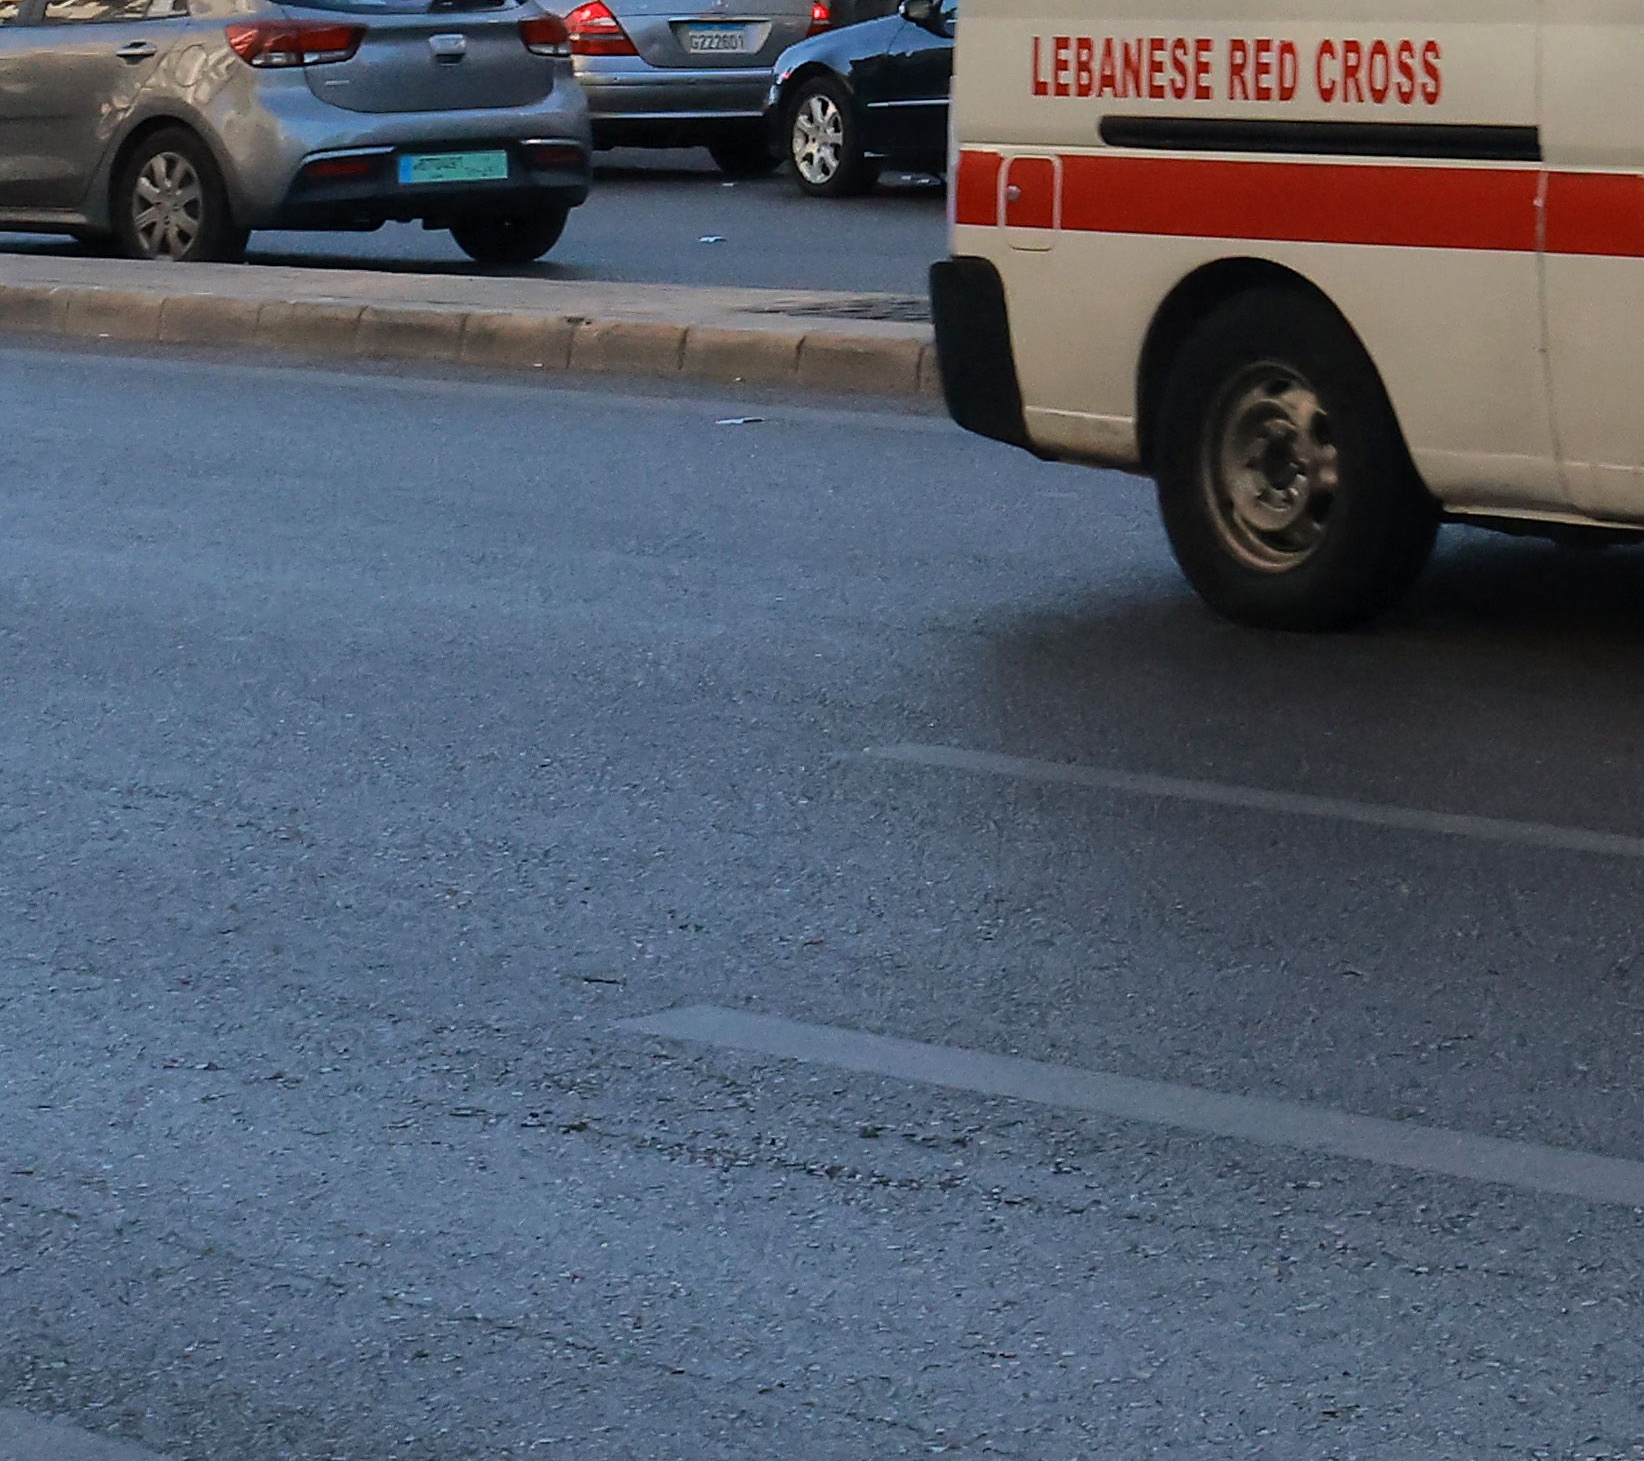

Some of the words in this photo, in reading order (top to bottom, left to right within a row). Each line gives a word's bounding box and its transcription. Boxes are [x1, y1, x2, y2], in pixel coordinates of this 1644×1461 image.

[1032, 35, 1213, 100] LEBANESE
[1228, 38, 1298, 103] RED
[1315, 38, 1442, 106] CROSS
